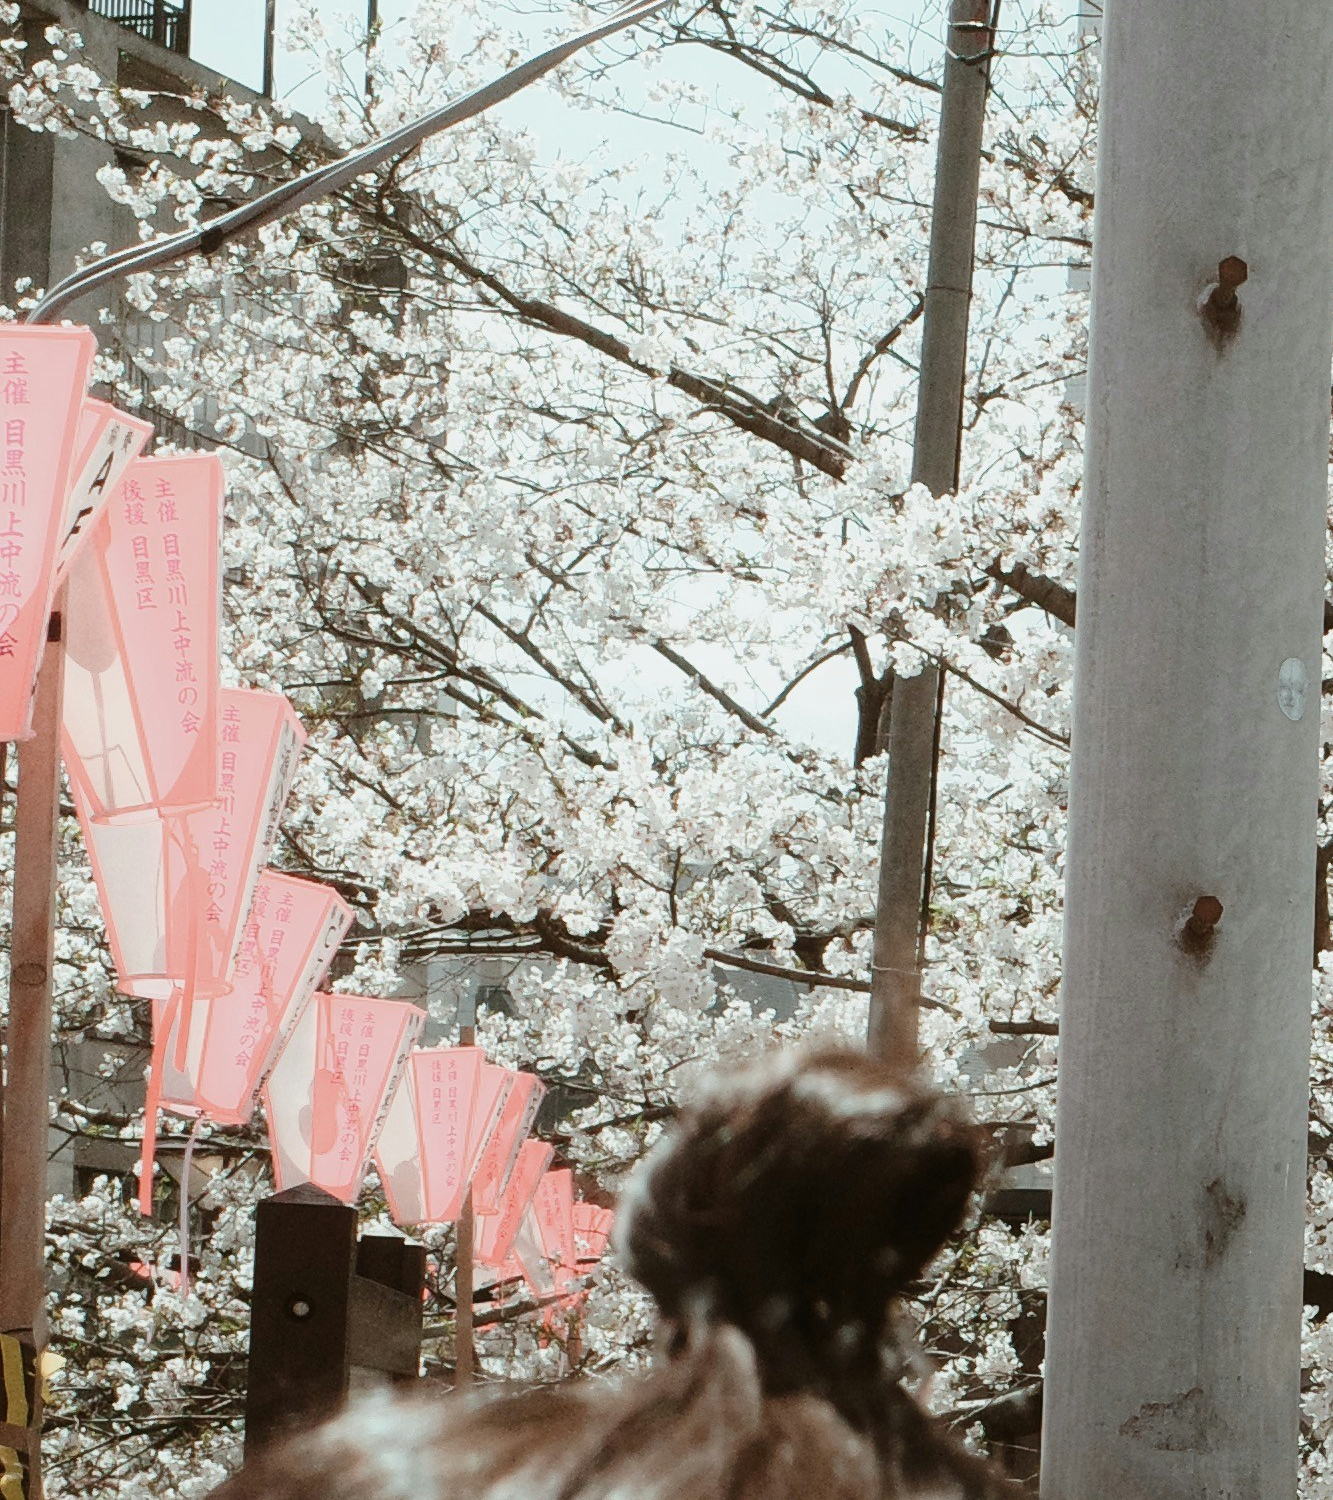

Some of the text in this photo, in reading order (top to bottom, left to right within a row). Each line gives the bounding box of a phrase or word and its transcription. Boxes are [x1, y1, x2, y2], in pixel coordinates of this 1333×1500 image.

[2, 350, 30, 406] 主催
[122, 479, 157, 611] 後援 目黒区
[155, 478, 201, 735] 主催 目黒川上中流の会
[221, 704, 241, 743] 主催
[275, 891, 294, 924] 主催
